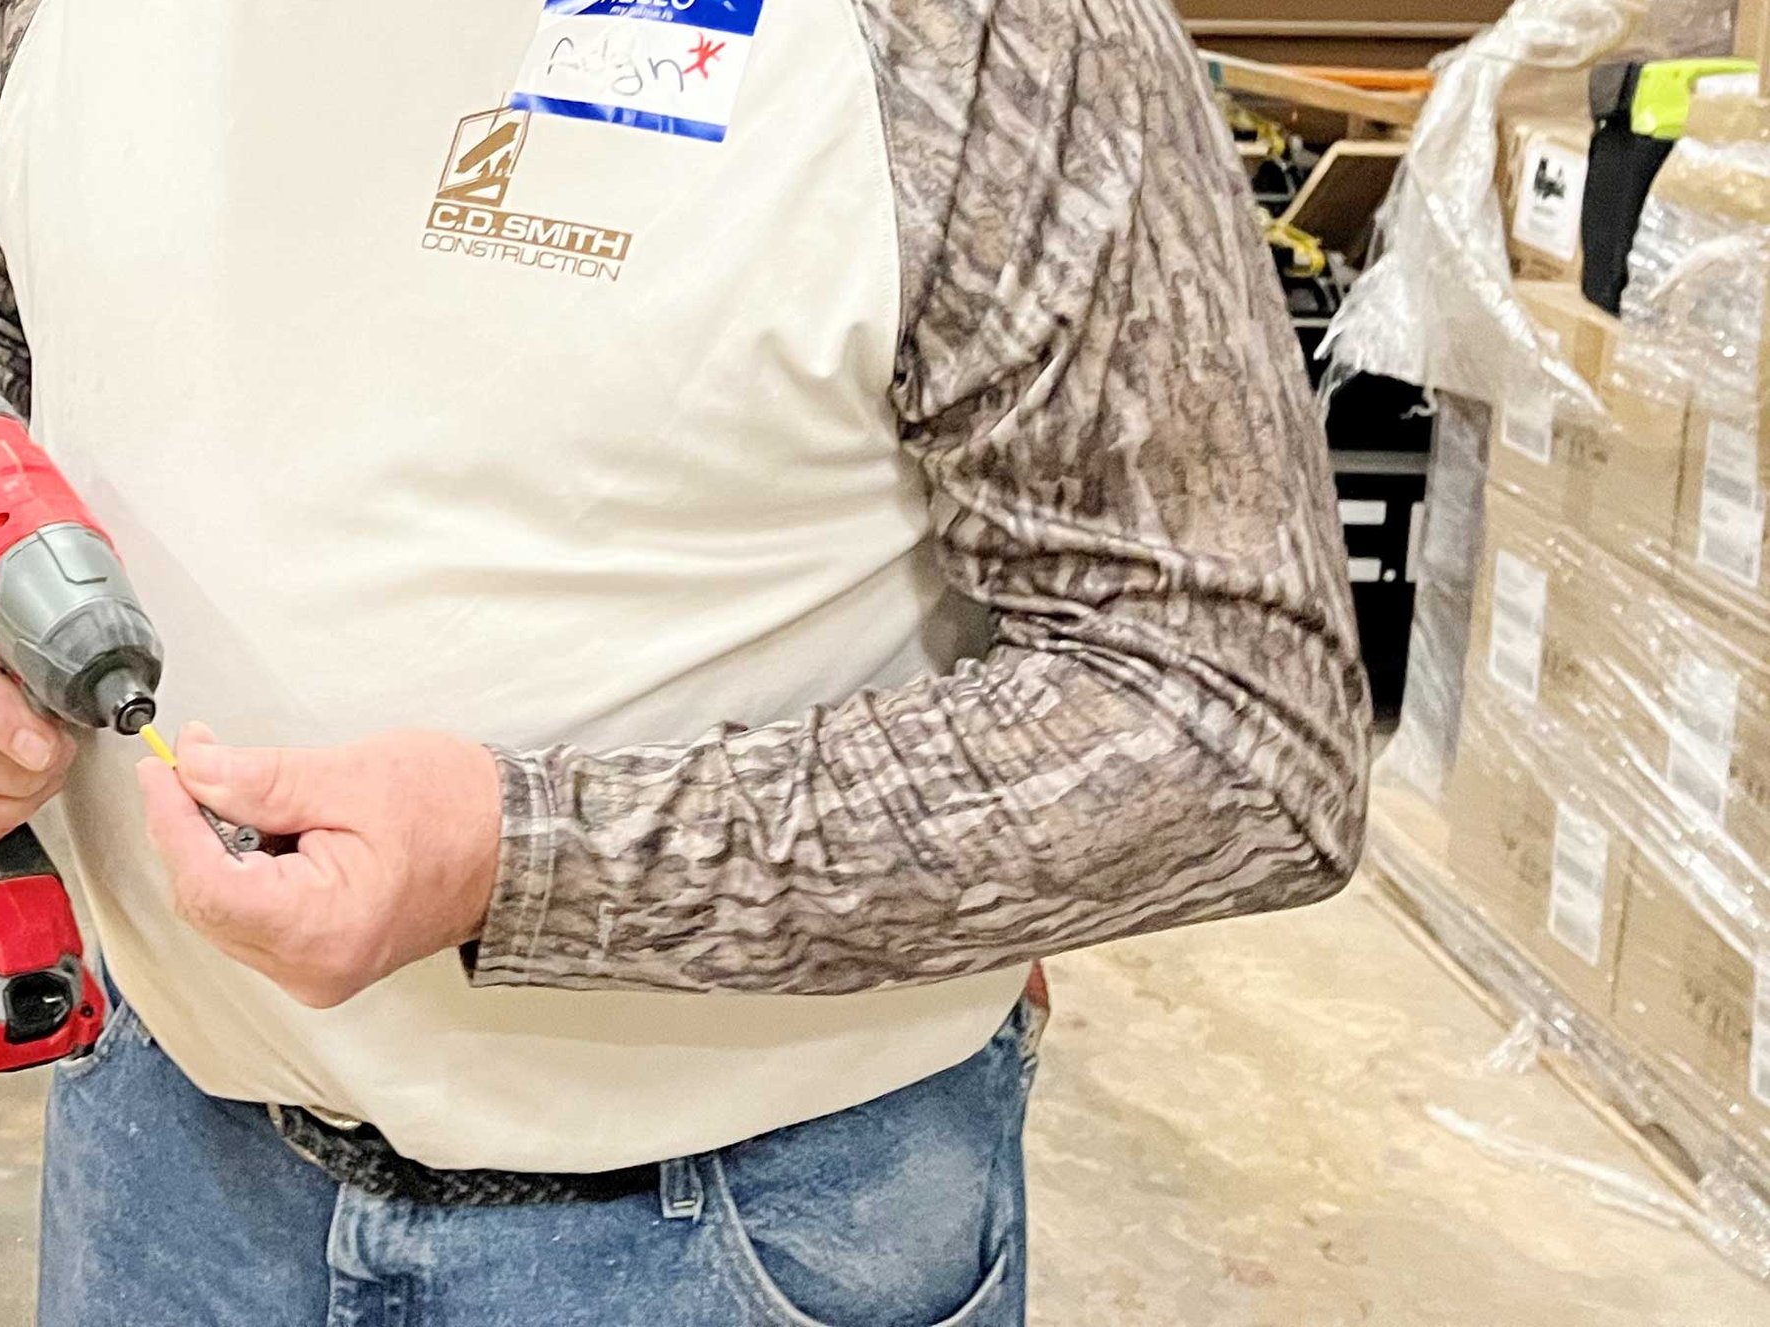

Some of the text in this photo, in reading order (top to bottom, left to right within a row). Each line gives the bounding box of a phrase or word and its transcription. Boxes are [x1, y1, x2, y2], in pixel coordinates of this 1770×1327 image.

[432, 204, 625, 257] C.D. SMITH
[422, 232, 621, 282] CONSTRUCTION
